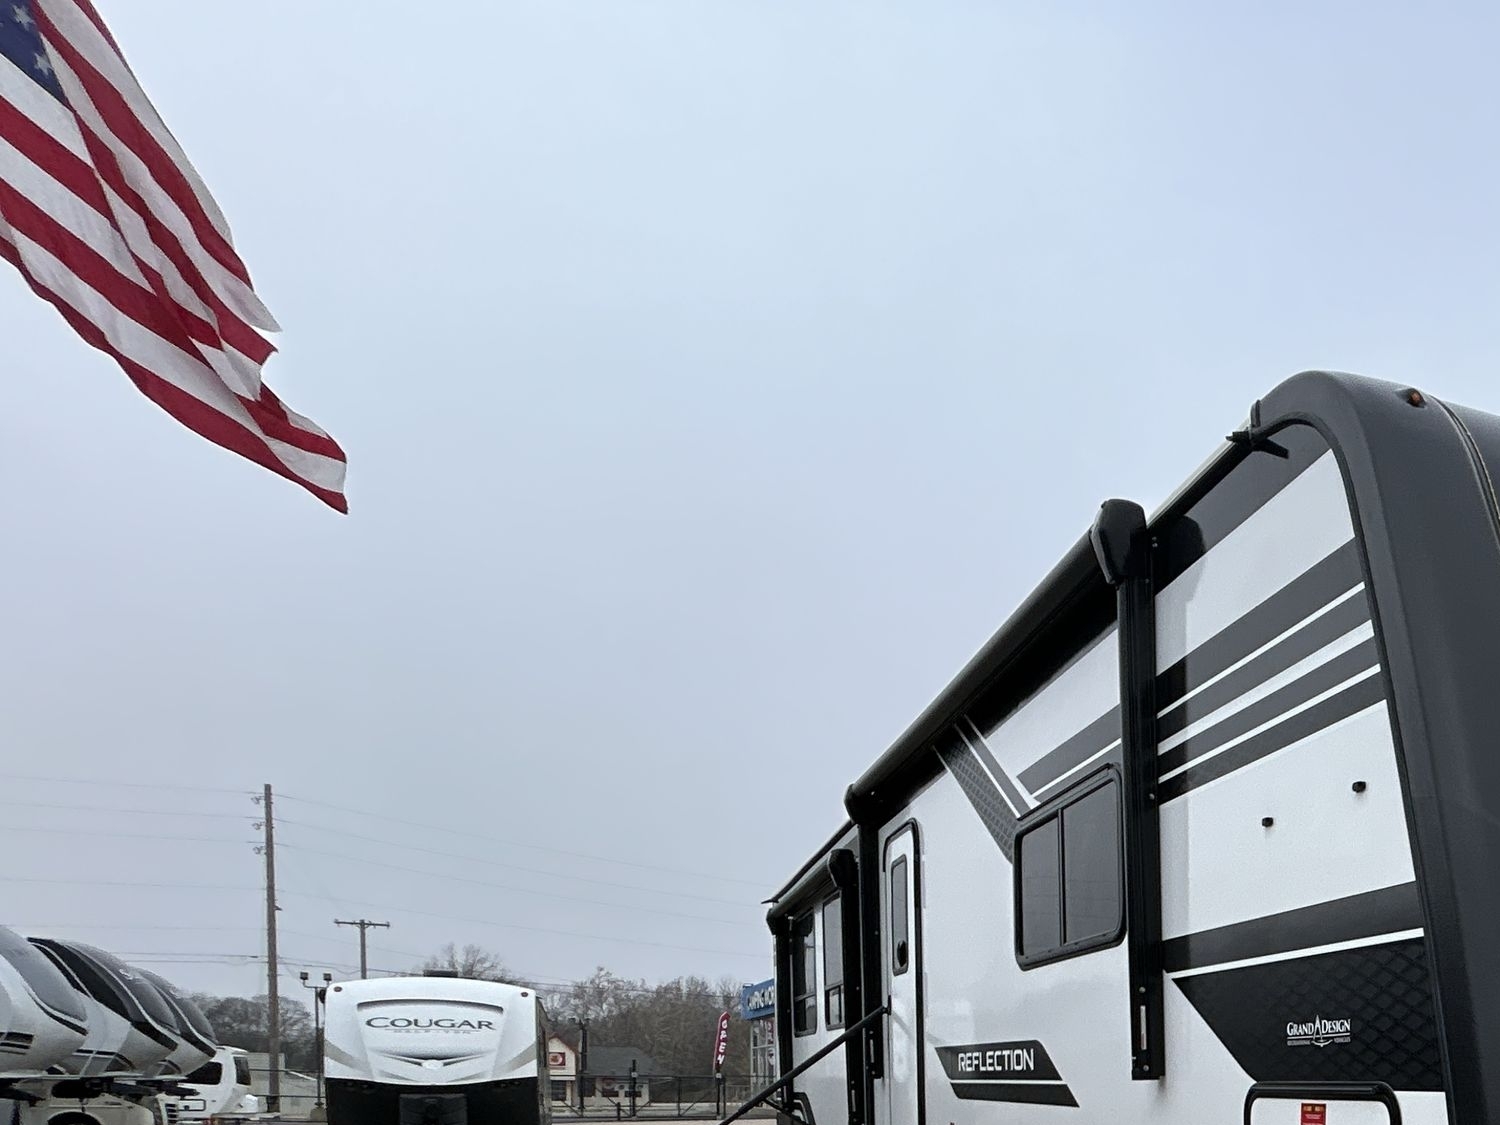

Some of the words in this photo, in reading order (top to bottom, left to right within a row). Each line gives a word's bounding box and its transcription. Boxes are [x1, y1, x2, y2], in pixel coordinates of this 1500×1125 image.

[365, 1017, 497, 1030] COUGAR
[1286, 1021, 1315, 1036] GRAND
[1321, 1018, 1351, 1034] DESIGN
[717, 1020, 728, 1064] OPEN
[958, 1048, 1034, 1072] REFLECTION
